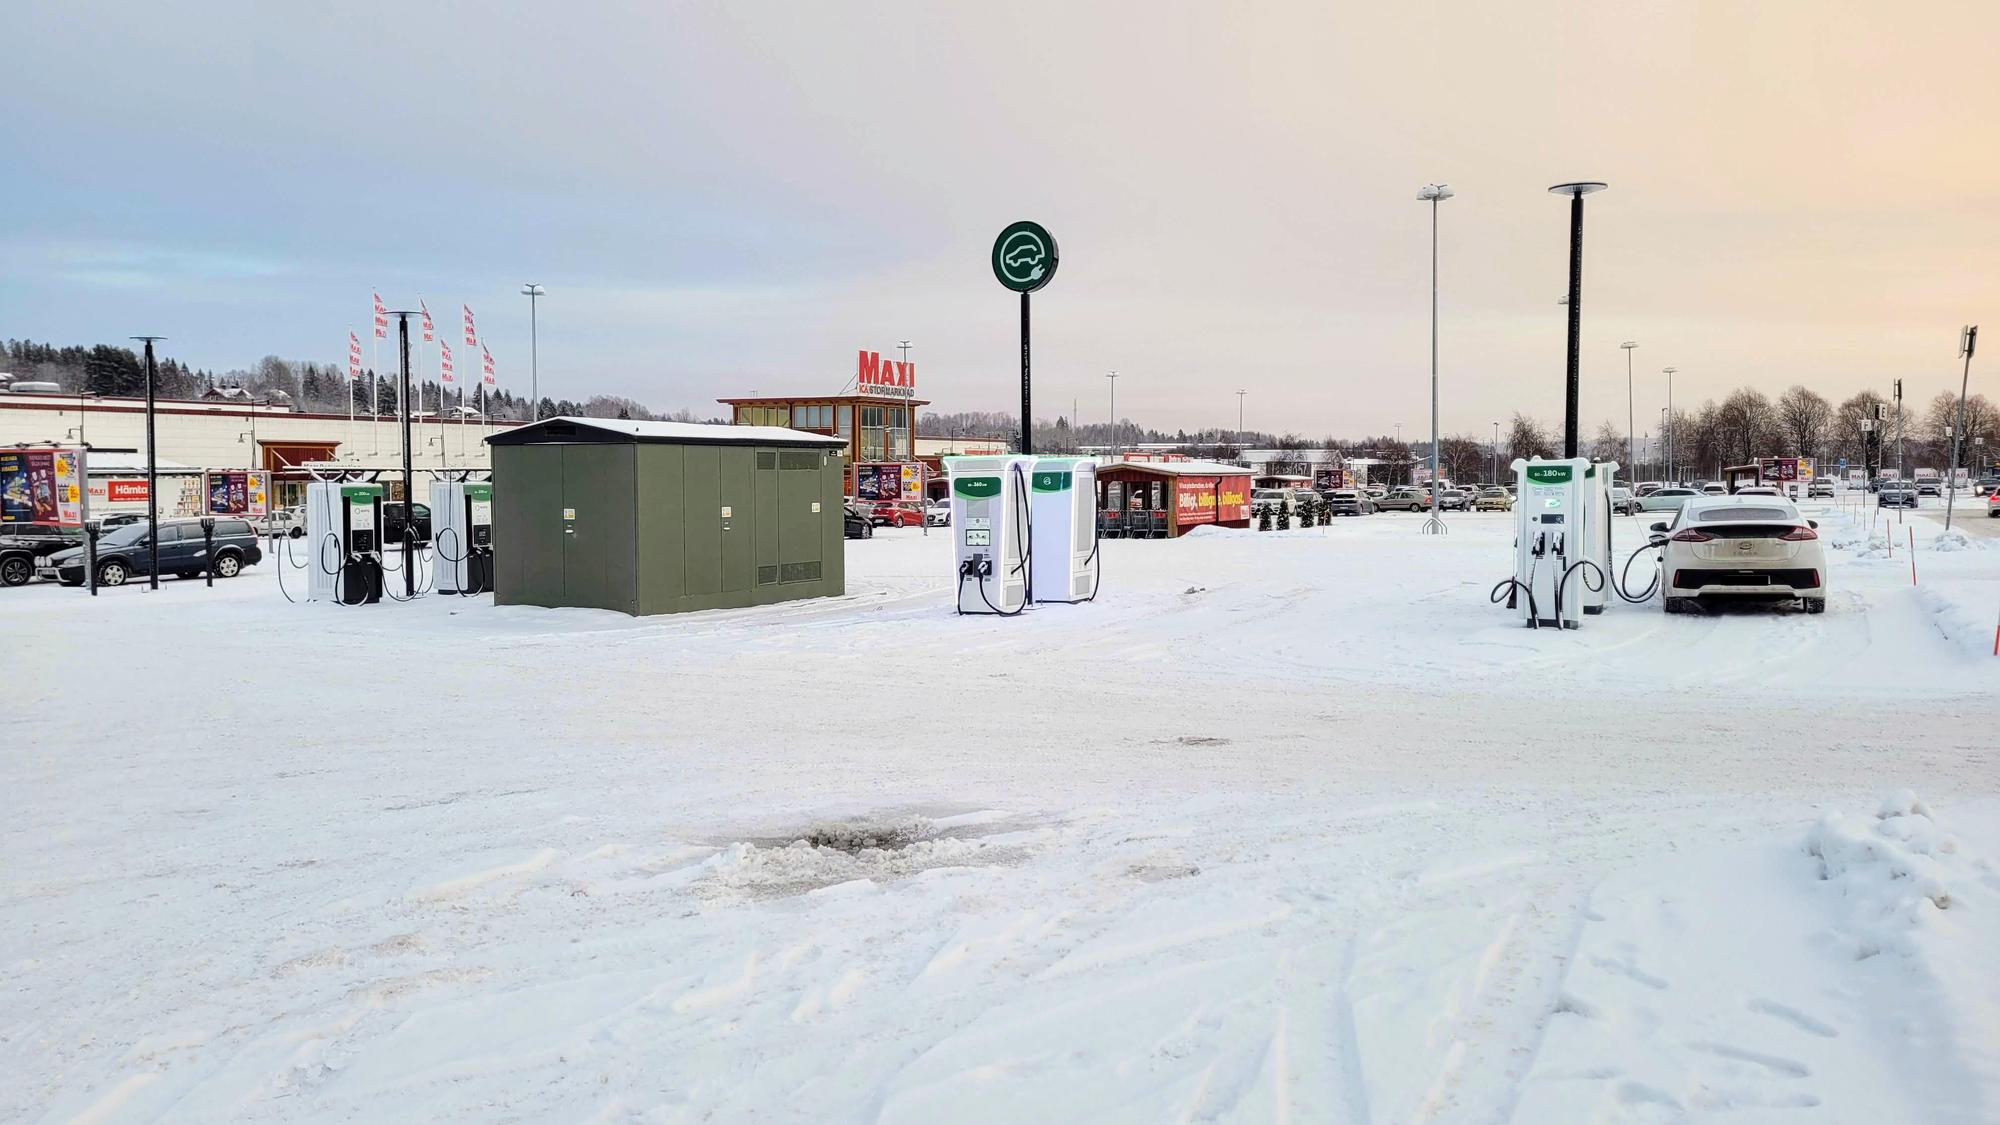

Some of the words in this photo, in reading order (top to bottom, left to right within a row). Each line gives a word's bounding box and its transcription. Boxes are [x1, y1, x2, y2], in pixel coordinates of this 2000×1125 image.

[859, 351, 915, 388] MAXI
[1882, 407, 1886, 418] E
[1864, 422, 1869, 430] F
[115, 485, 148, 495] Hämta
[1179, 493, 1197, 510] Billigt,
[1223, 491, 1244, 507] billigast.
